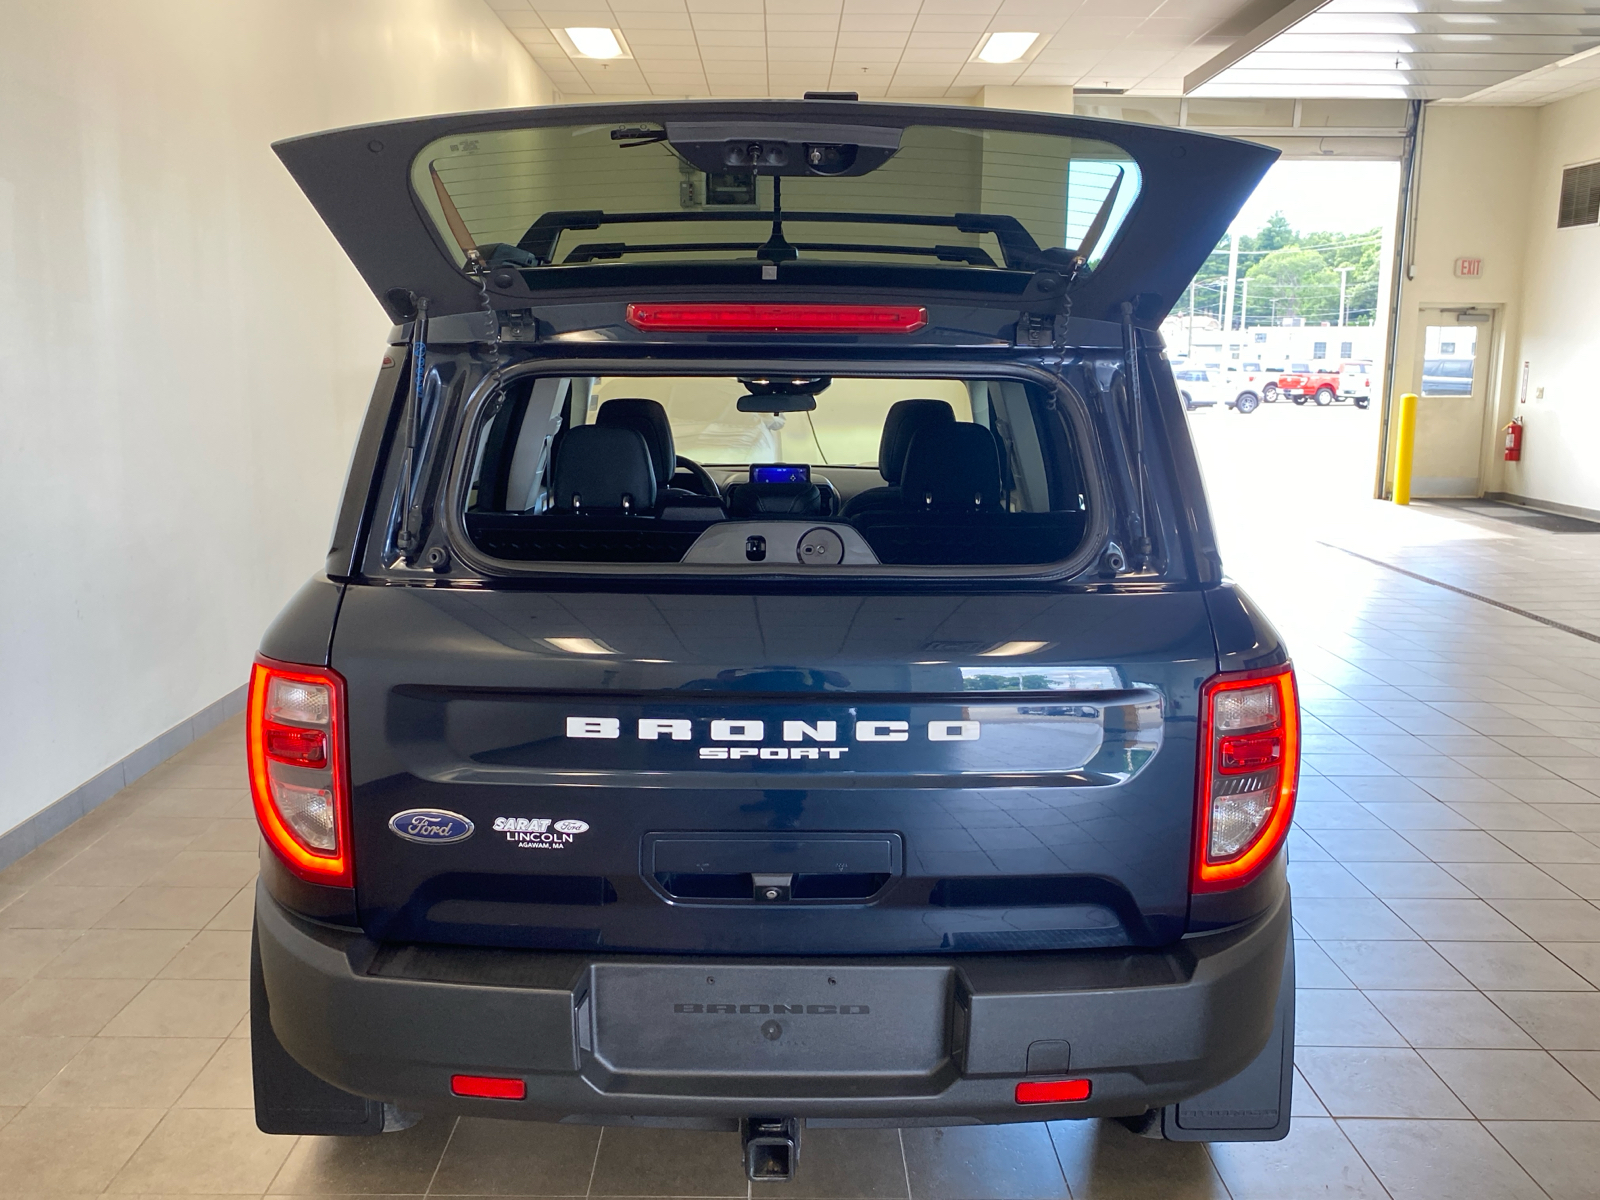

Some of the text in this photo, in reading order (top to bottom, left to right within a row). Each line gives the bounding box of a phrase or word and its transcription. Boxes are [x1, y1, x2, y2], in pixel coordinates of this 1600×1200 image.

[1460, 259, 1481, 276] EXIT
[566, 716, 981, 742] BRONCO
[698, 747, 849, 760] SPORT
[407, 815, 453, 837] Ford
[492, 816, 552, 832] SARAT
[506, 832, 573, 842] LINCOLN
[673, 1003, 870, 1015] BRONCO
